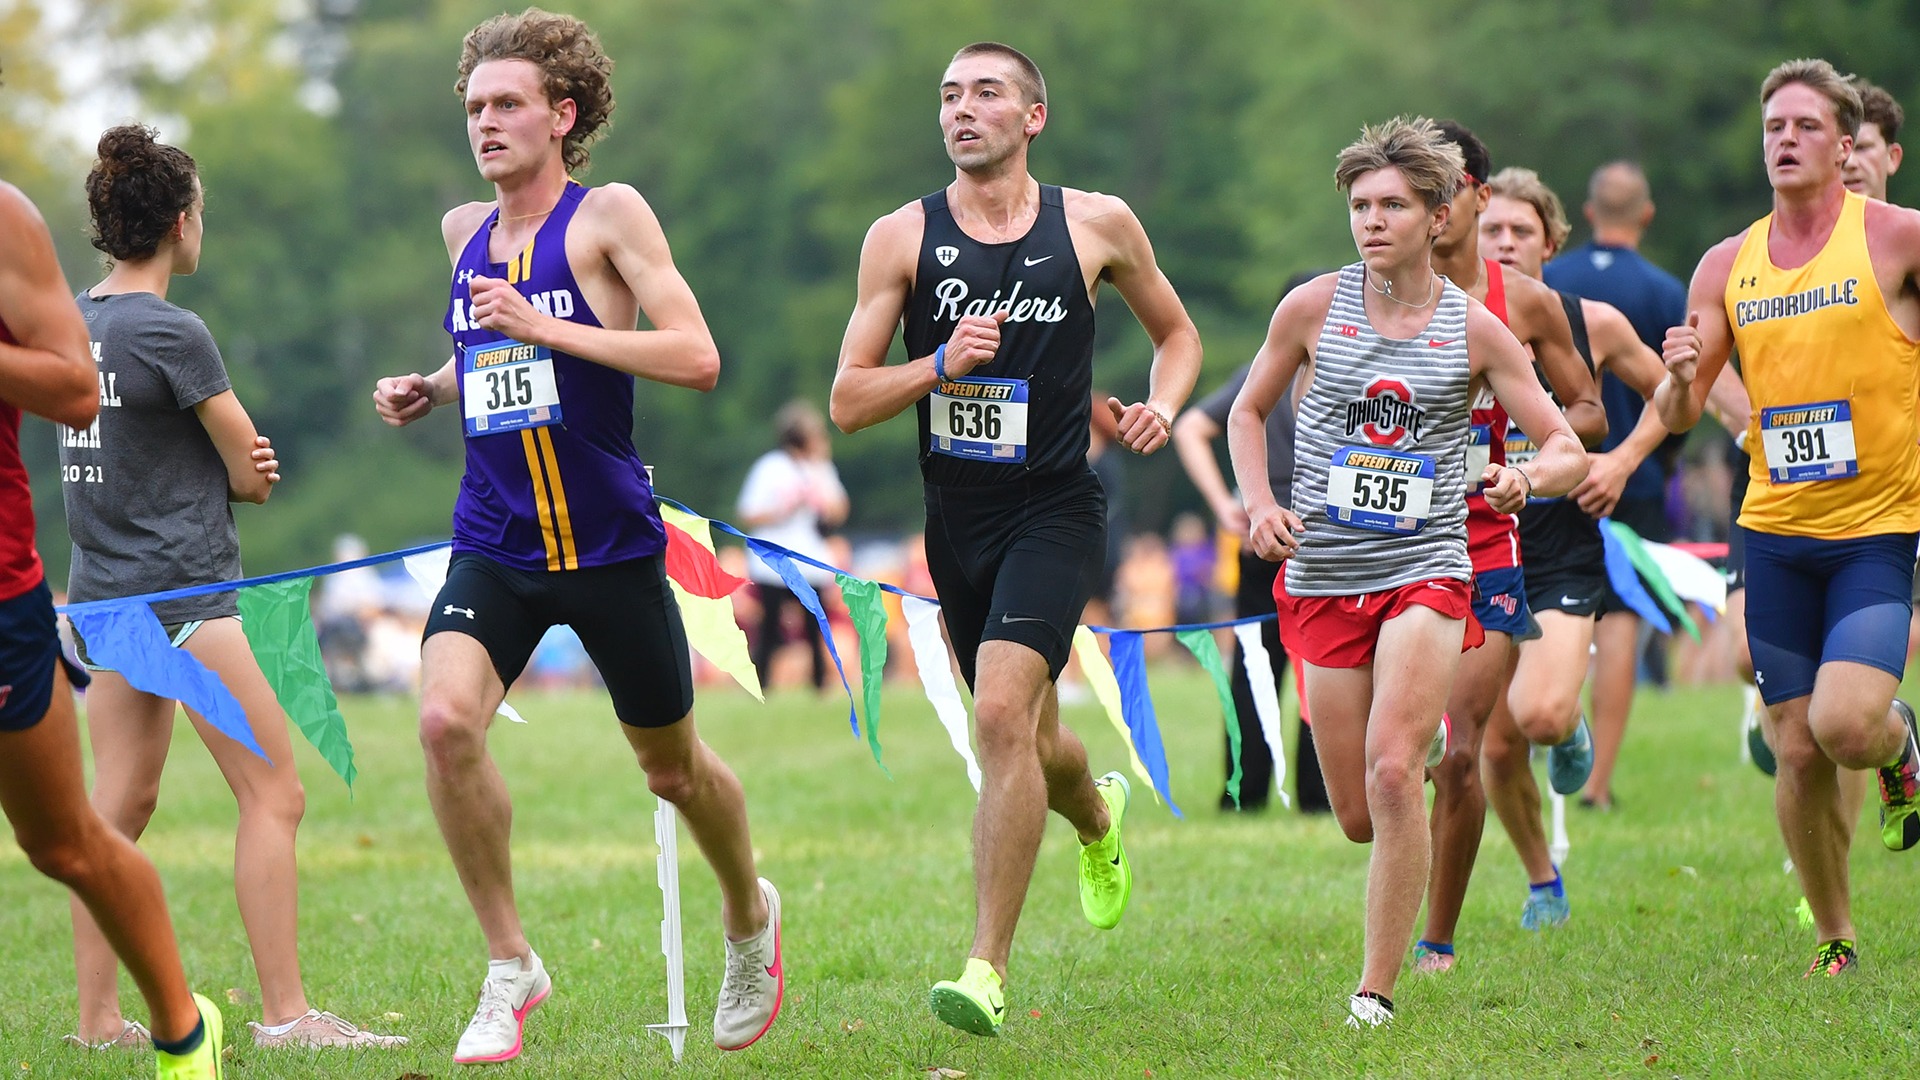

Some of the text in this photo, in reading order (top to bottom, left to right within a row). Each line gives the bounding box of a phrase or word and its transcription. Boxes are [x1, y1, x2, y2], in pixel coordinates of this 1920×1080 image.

[933, 278, 1067, 322] Raiders
[1735, 278, 1858, 327] CEDARVILLE
[476, 345, 535, 368] SPEEDY FEET
[485, 367, 533, 411] 315
[940, 382, 1012, 399] SPEEDY FEET
[949, 401, 1002, 440] 636
[1345, 397, 1379, 437] OHIO
[1379, 395, 1426, 444] STATE
[1771, 408, 1835, 427] SPEEDY FEET
[1347, 453, 1420, 474] SPEEDY FEET
[1781, 428, 1830, 463] 391
[1352, 473, 1409, 512] 535
